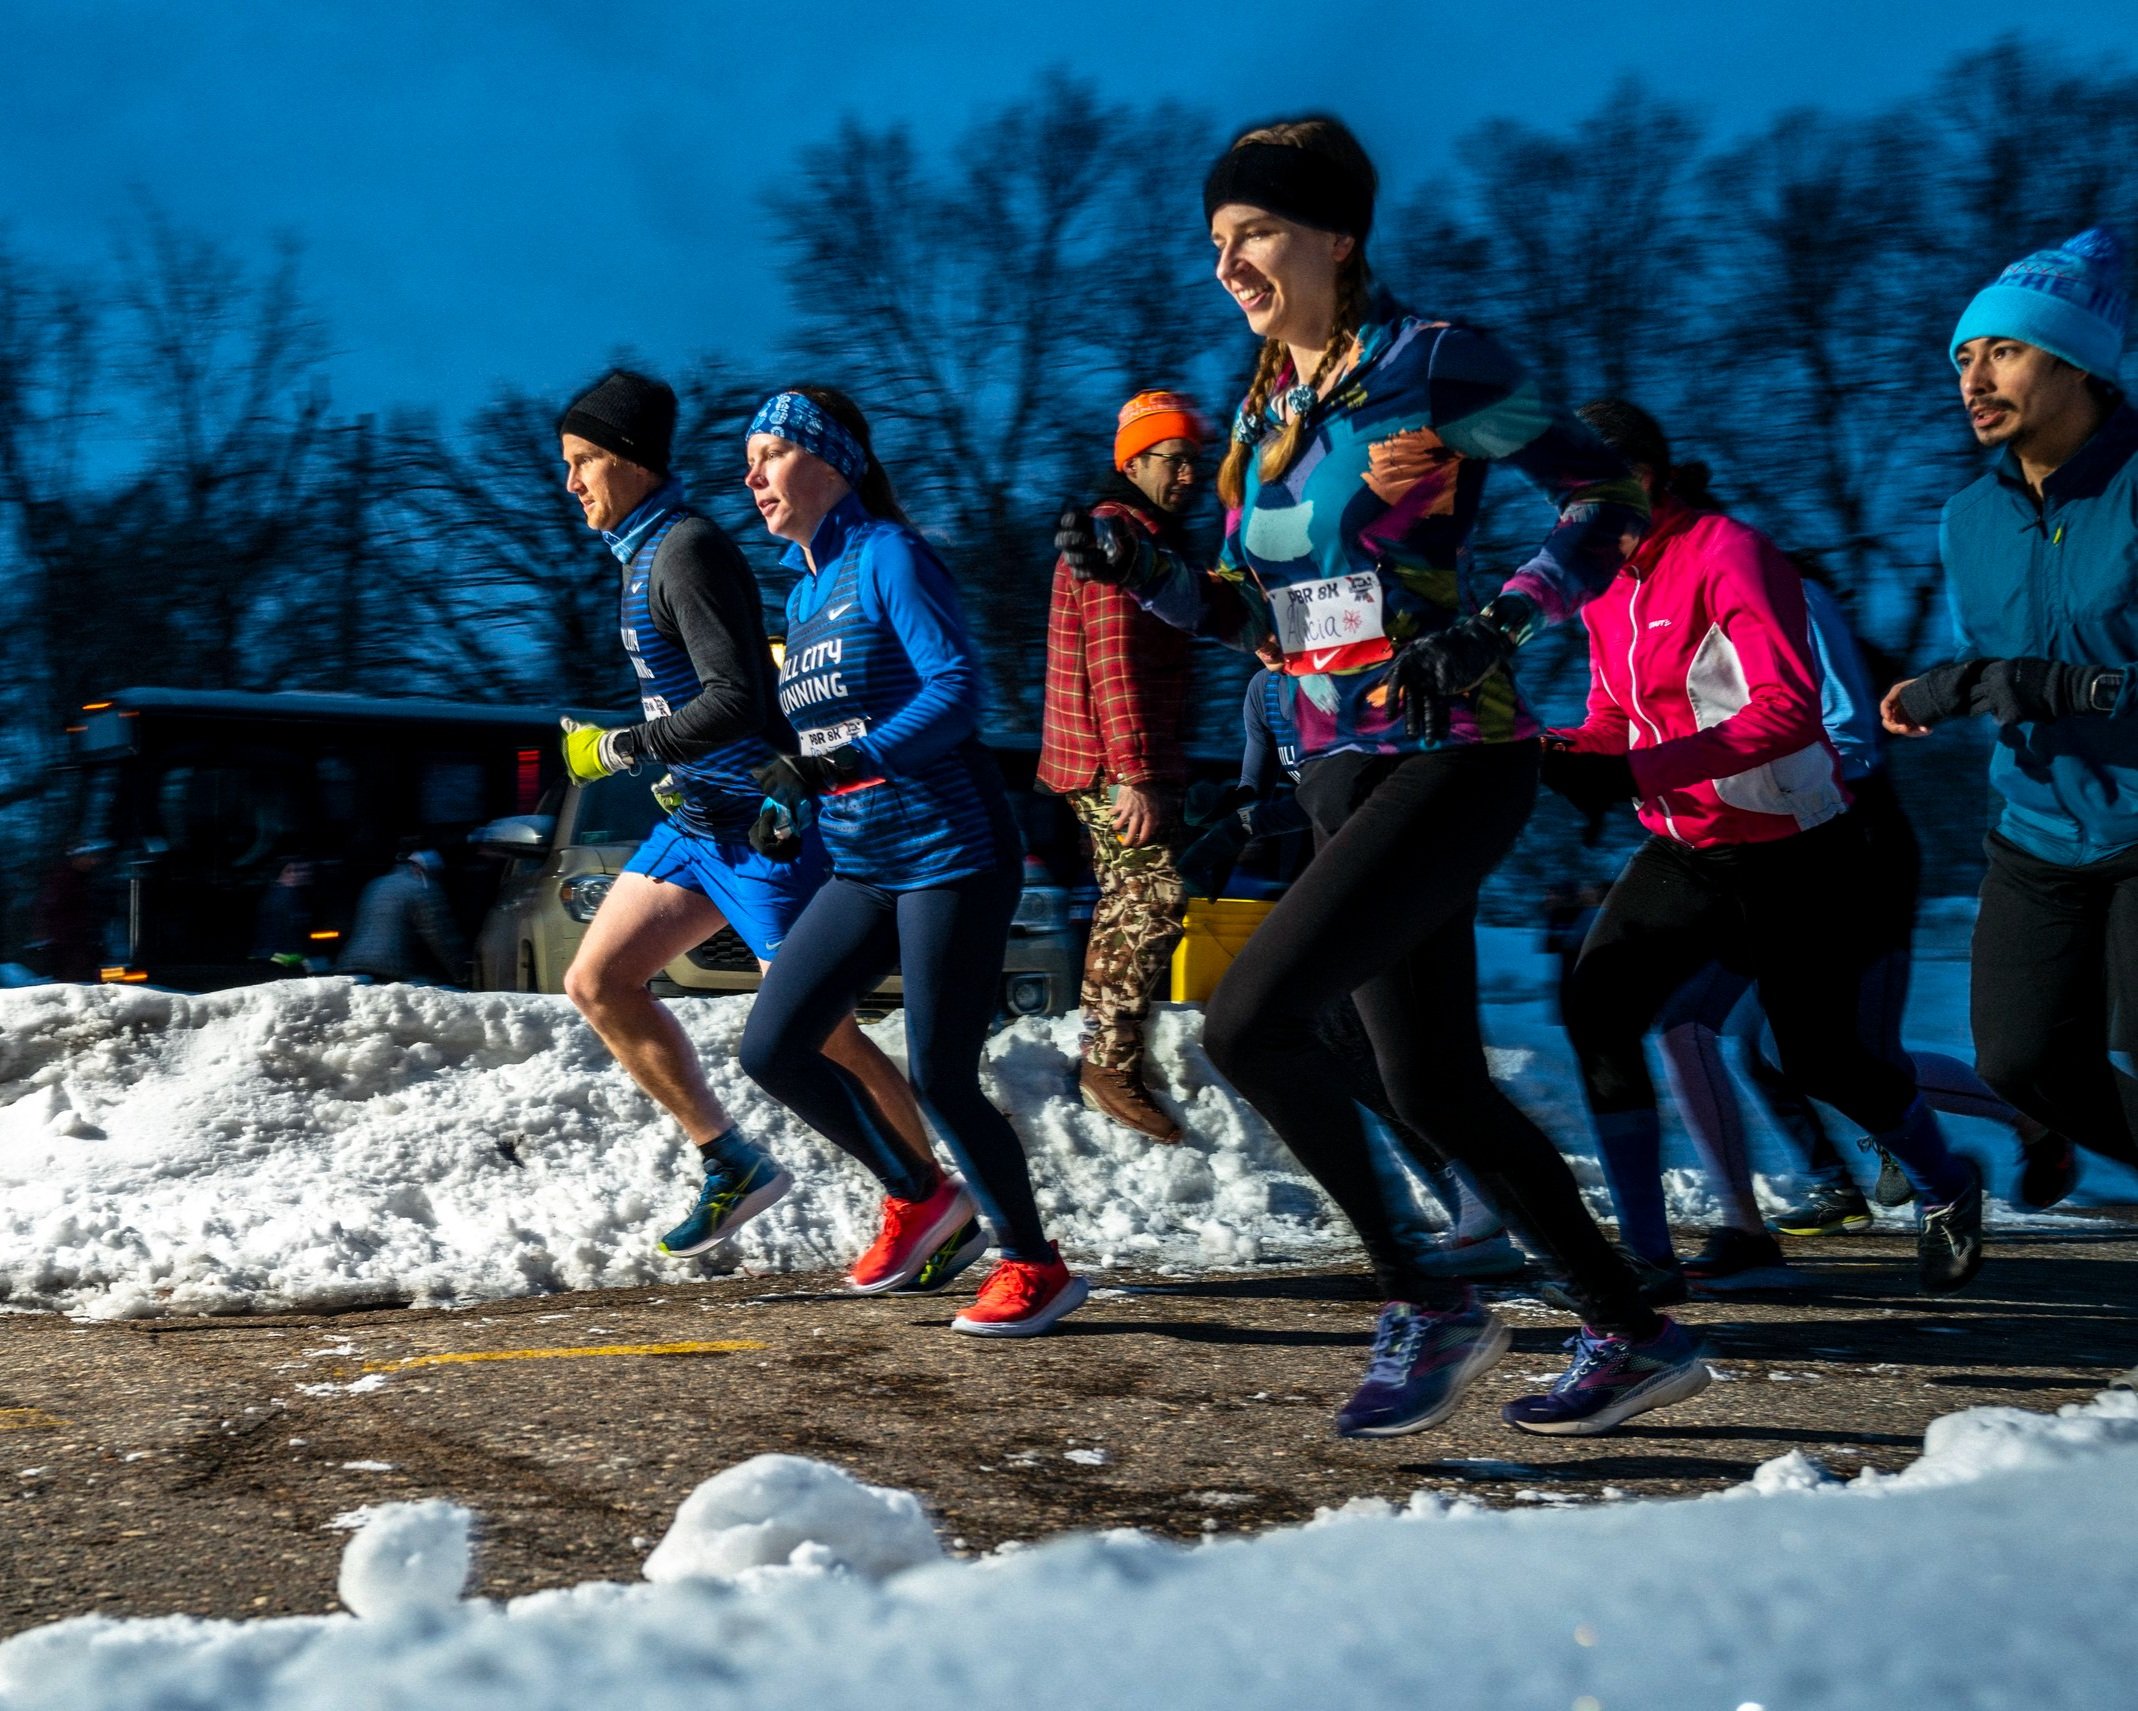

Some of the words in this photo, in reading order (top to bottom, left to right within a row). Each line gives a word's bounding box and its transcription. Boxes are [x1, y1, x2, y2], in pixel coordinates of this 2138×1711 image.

[1287, 587, 1314, 605] PBR
[1317, 583, 1341, 600] 8K
[801, 638, 842, 673] CITY
[779, 672, 849, 717] UNNING
[827, 727, 842, 742] 8K
